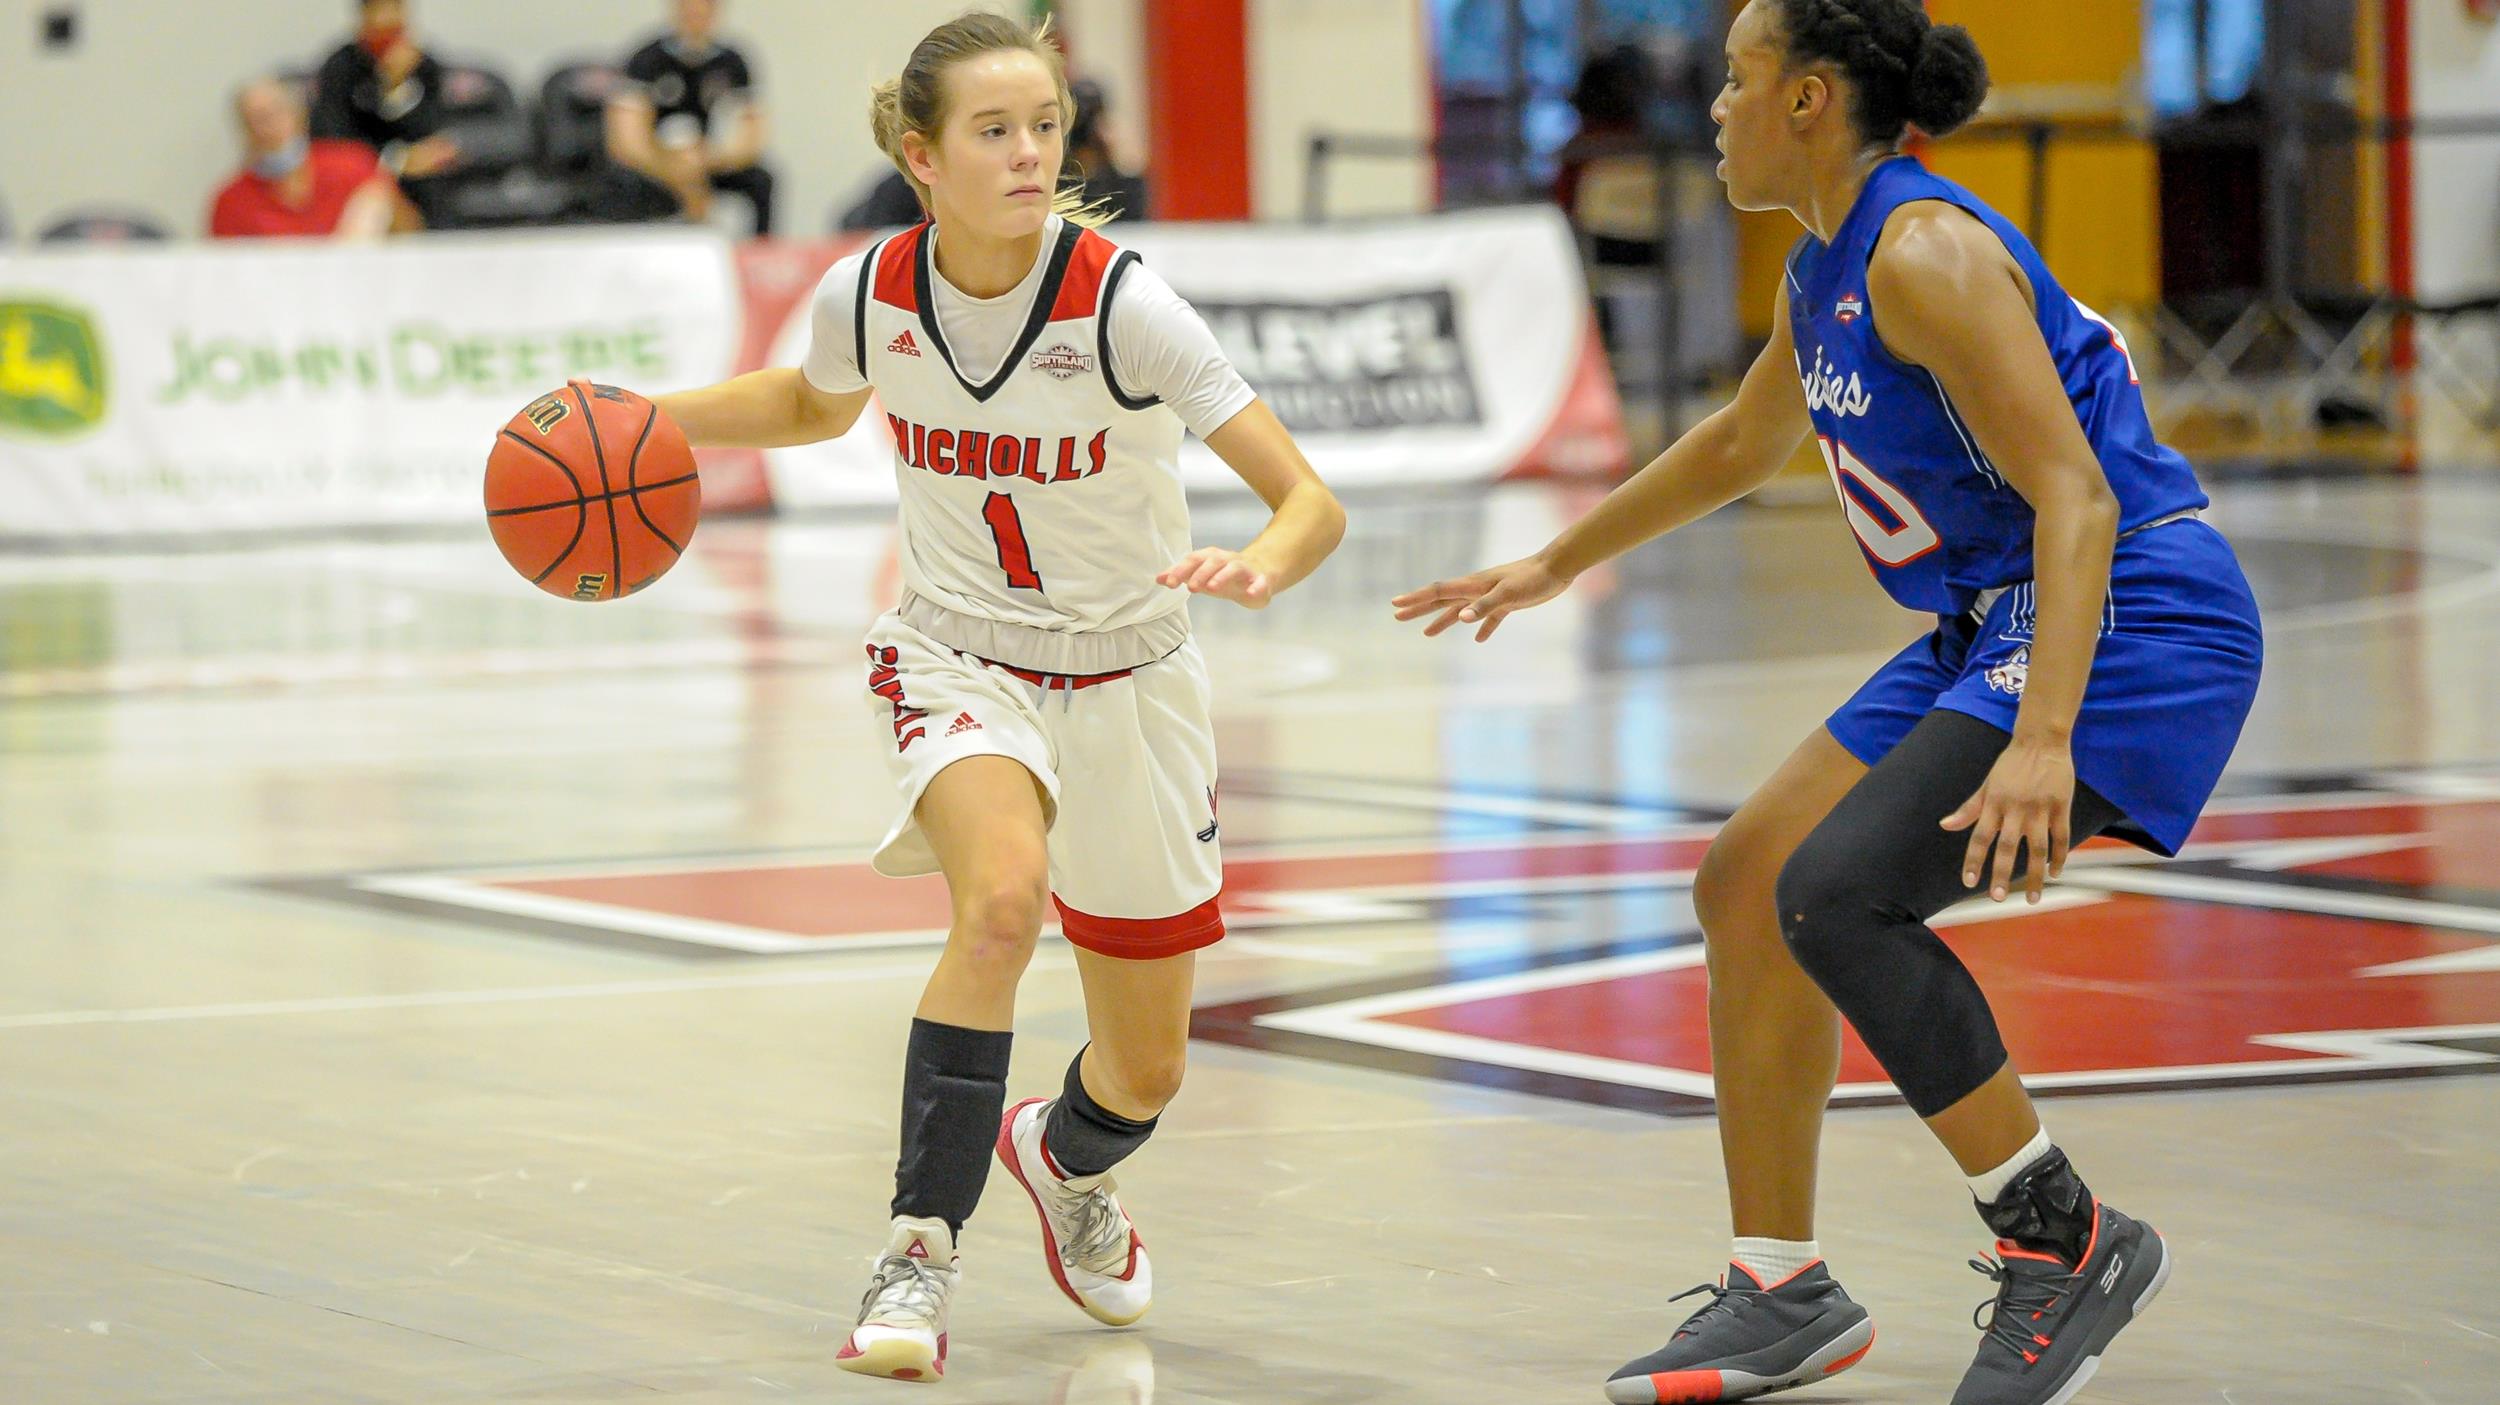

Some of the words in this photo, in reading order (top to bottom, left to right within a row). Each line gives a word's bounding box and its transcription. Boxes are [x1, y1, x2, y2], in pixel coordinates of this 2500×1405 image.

[887, 411, 1112, 485] NICHOLLS
[982, 490, 1044, 595] 1
[944, 723, 982, 738] adidas
